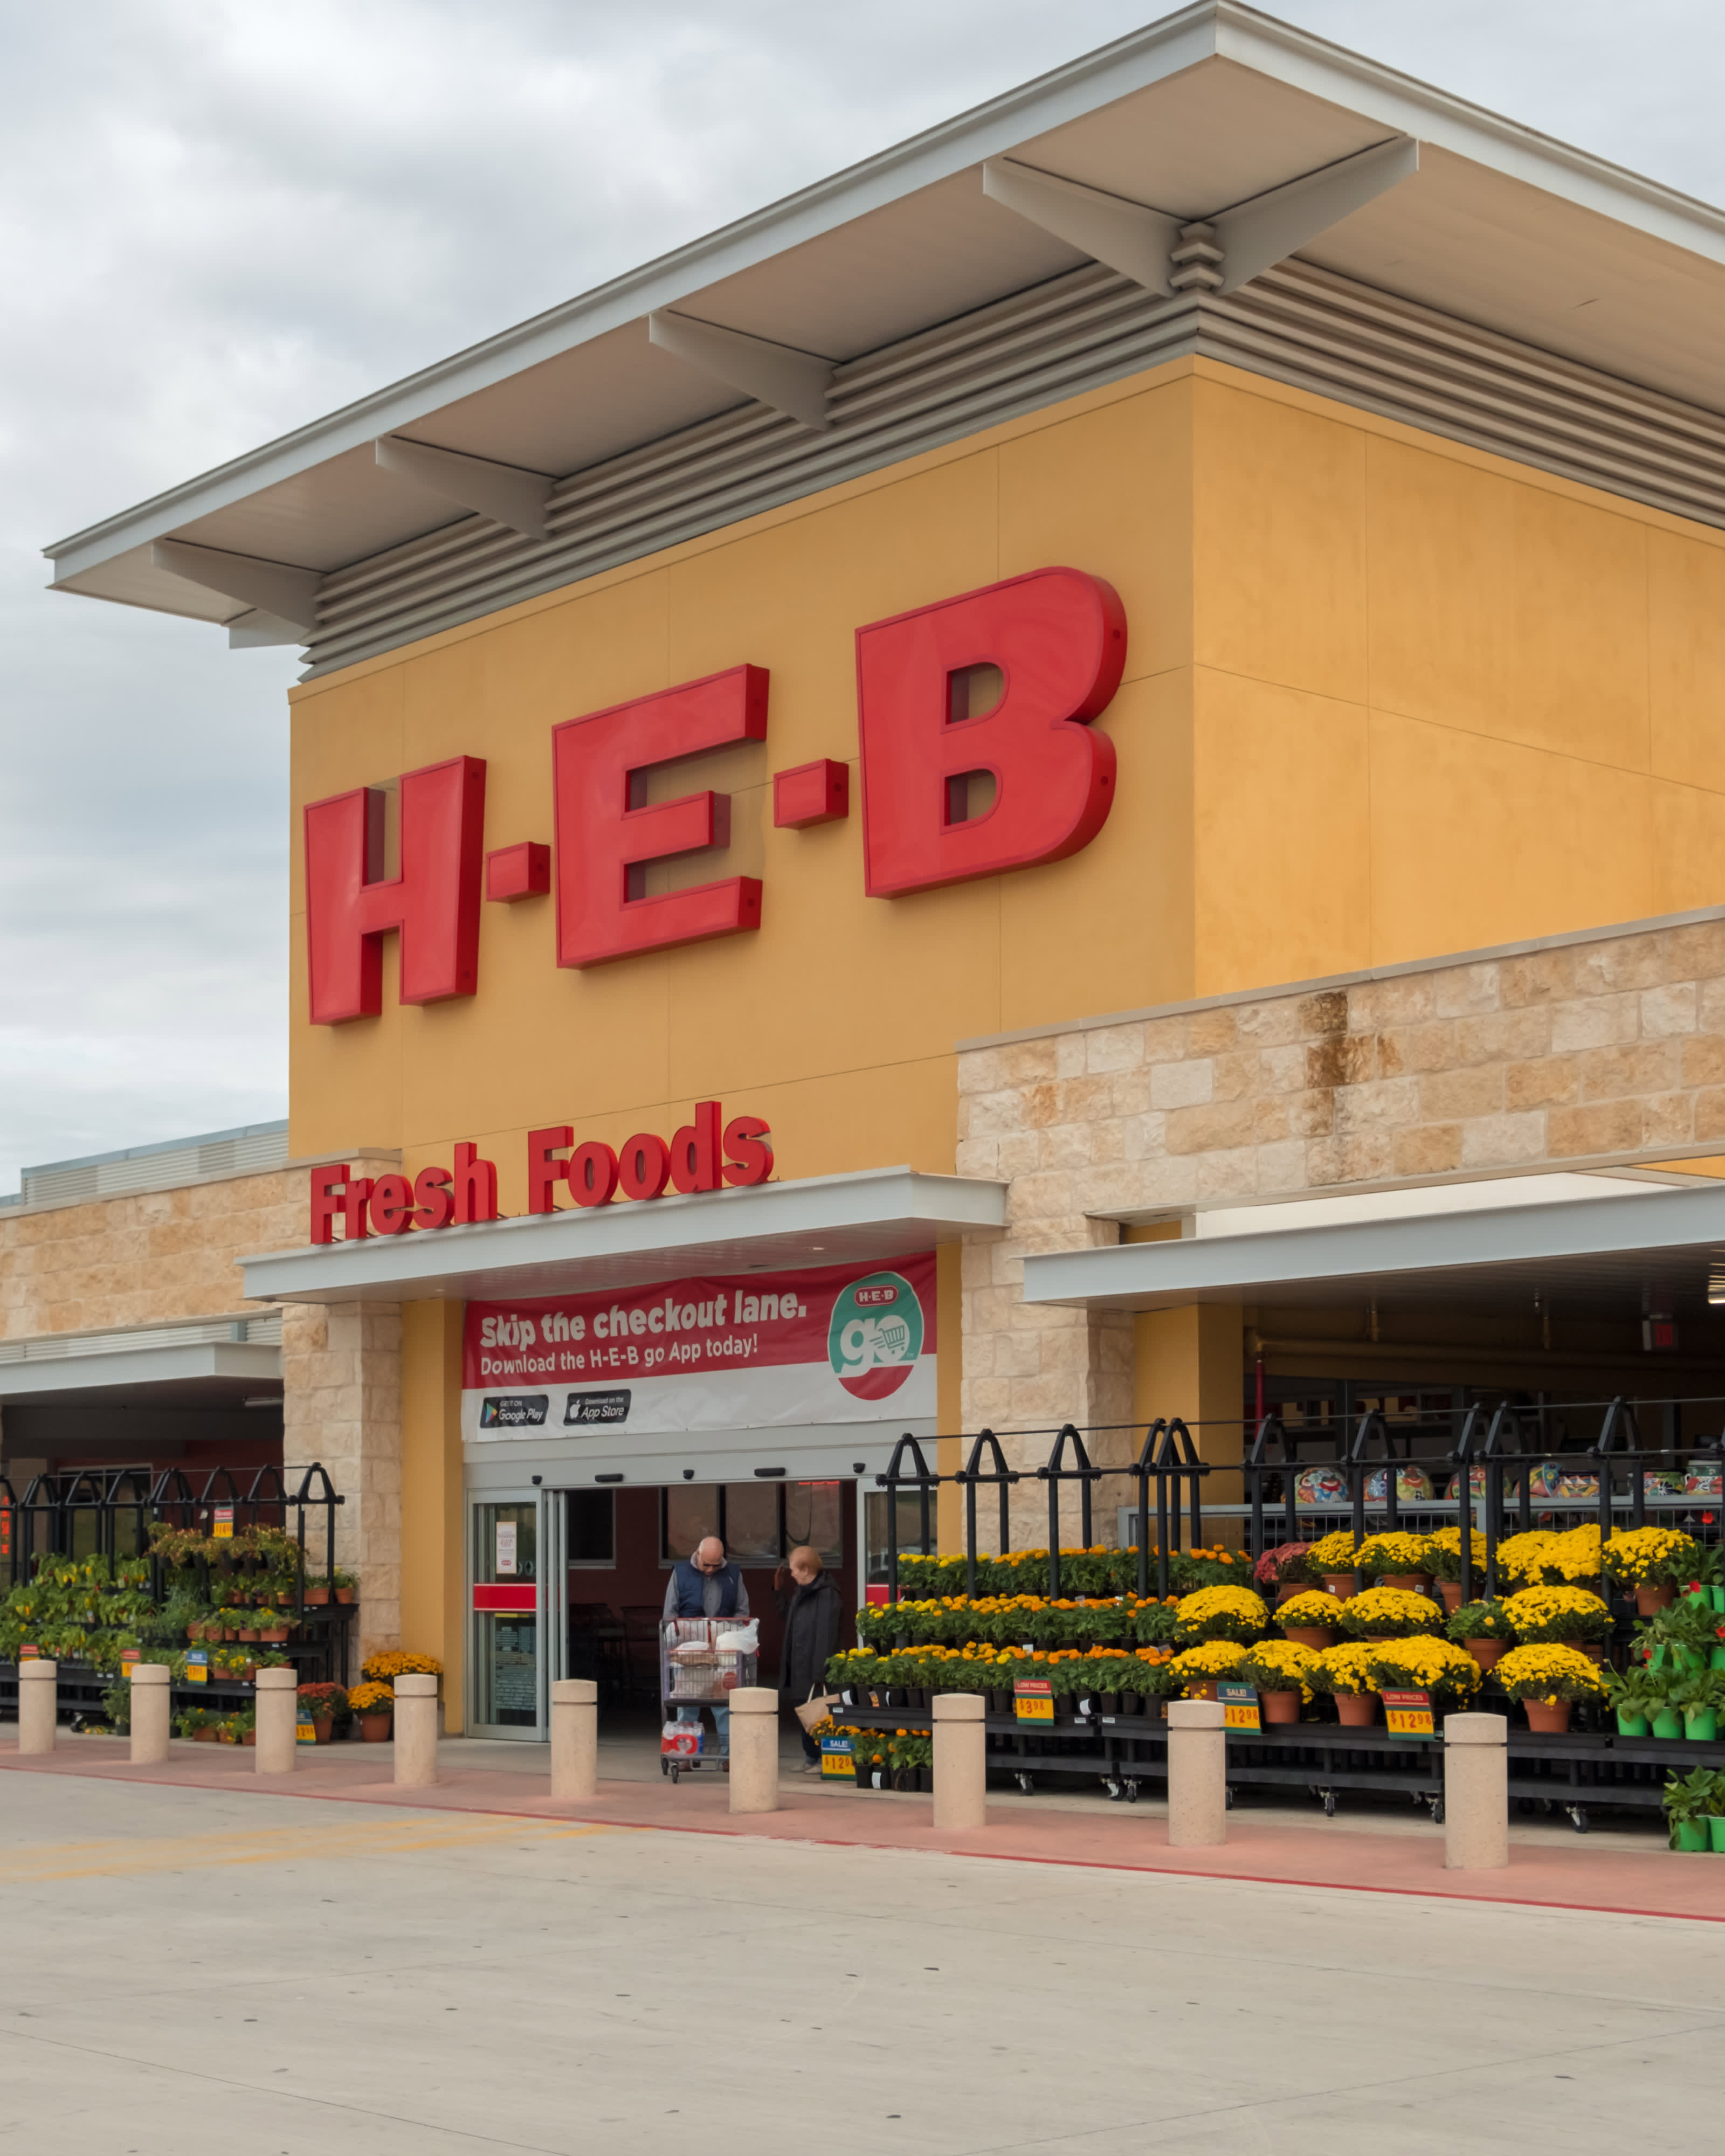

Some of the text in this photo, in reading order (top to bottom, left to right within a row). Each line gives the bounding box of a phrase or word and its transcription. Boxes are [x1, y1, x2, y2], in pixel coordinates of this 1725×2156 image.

[311, 1101, 774, 1244] Fresh Foods
[480, 1289, 807, 1351] Skip the checkout lane.
[481, 1333, 757, 1375] Download the H-E-B go App today!
[499, 1408, 543, 1422] Google Play
[581, 1405, 624, 1420] App Store
[1226, 1688, 1247, 1697] SALE!
